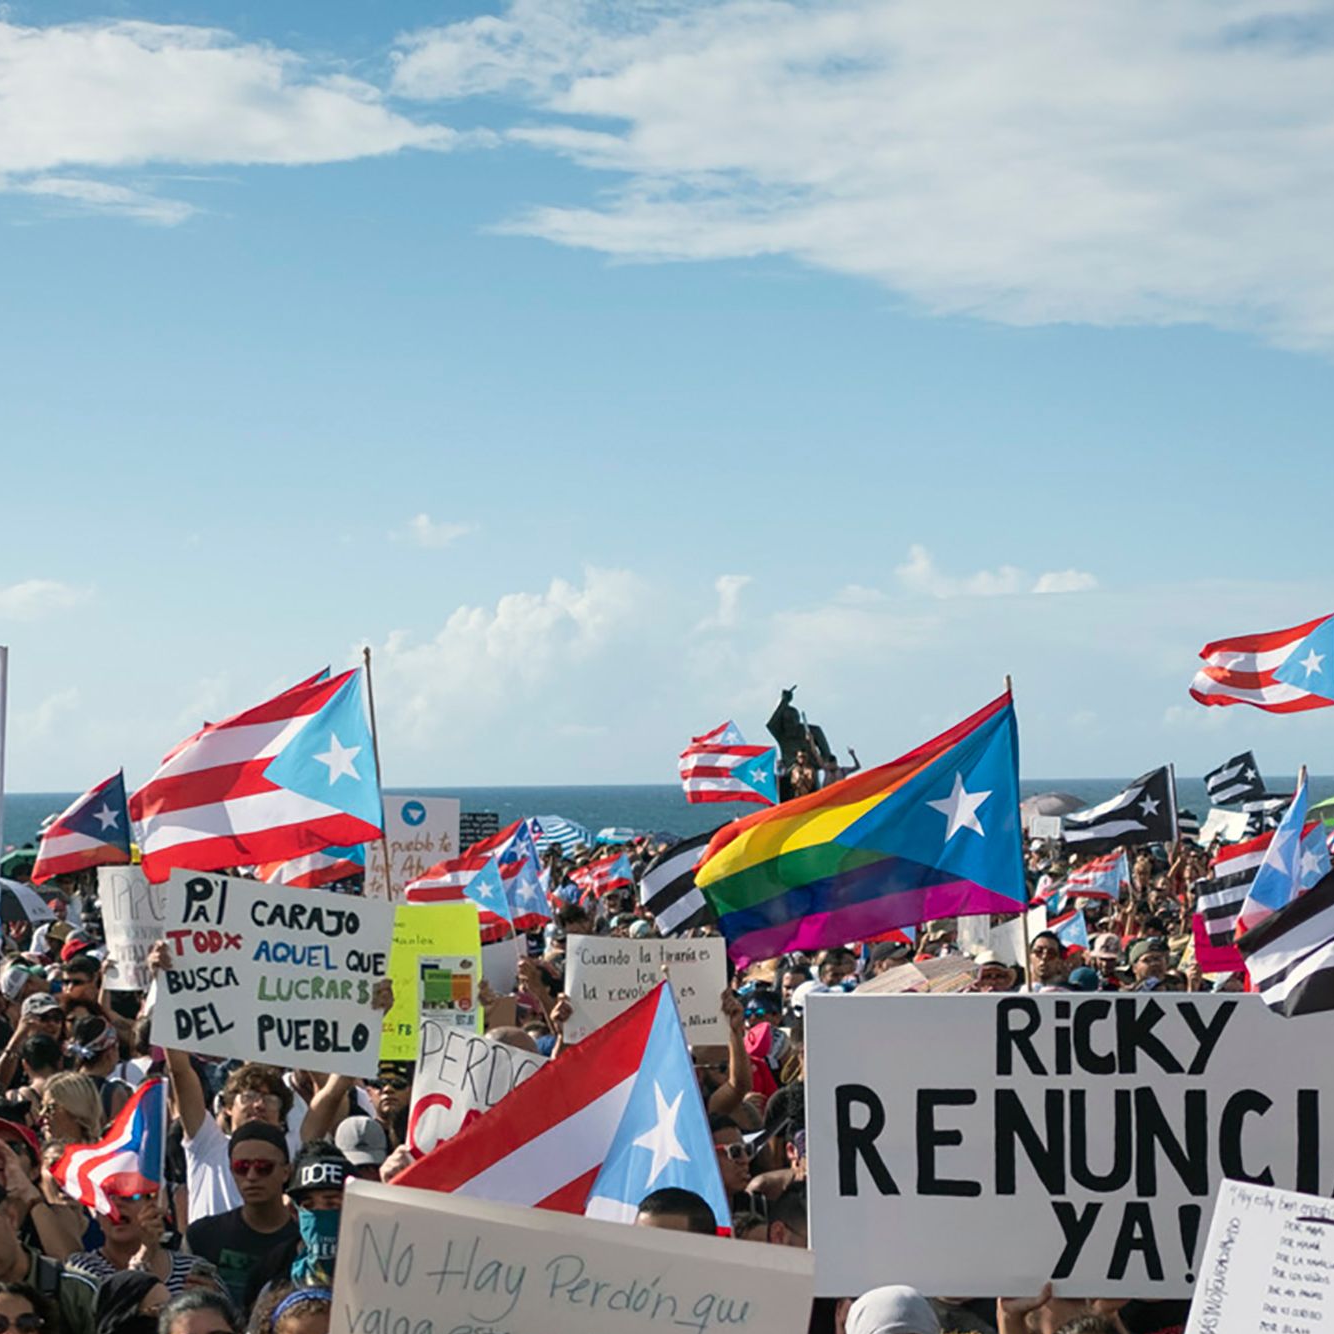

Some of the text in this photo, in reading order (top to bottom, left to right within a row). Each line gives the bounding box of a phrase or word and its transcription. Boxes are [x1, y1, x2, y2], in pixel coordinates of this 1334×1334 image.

[251, 900, 360, 937] CARAJO
[253, 940, 338, 970] AQUEL
[346, 950, 385, 976] QUE
[640, 946, 651, 963] la
[167, 966, 371, 1005] BUSCA LUCRAR$
[583, 983, 597, 999] la
[175, 1002, 370, 1053] DEL PUEBLO
[301, 1163, 342, 1186] DOPE
[1050, 1201, 1202, 1284] YA!
[354, 1221, 413, 1287] No
[427, 1236, 526, 1324] Hay
[547, 1254, 678, 1324] Perdón
